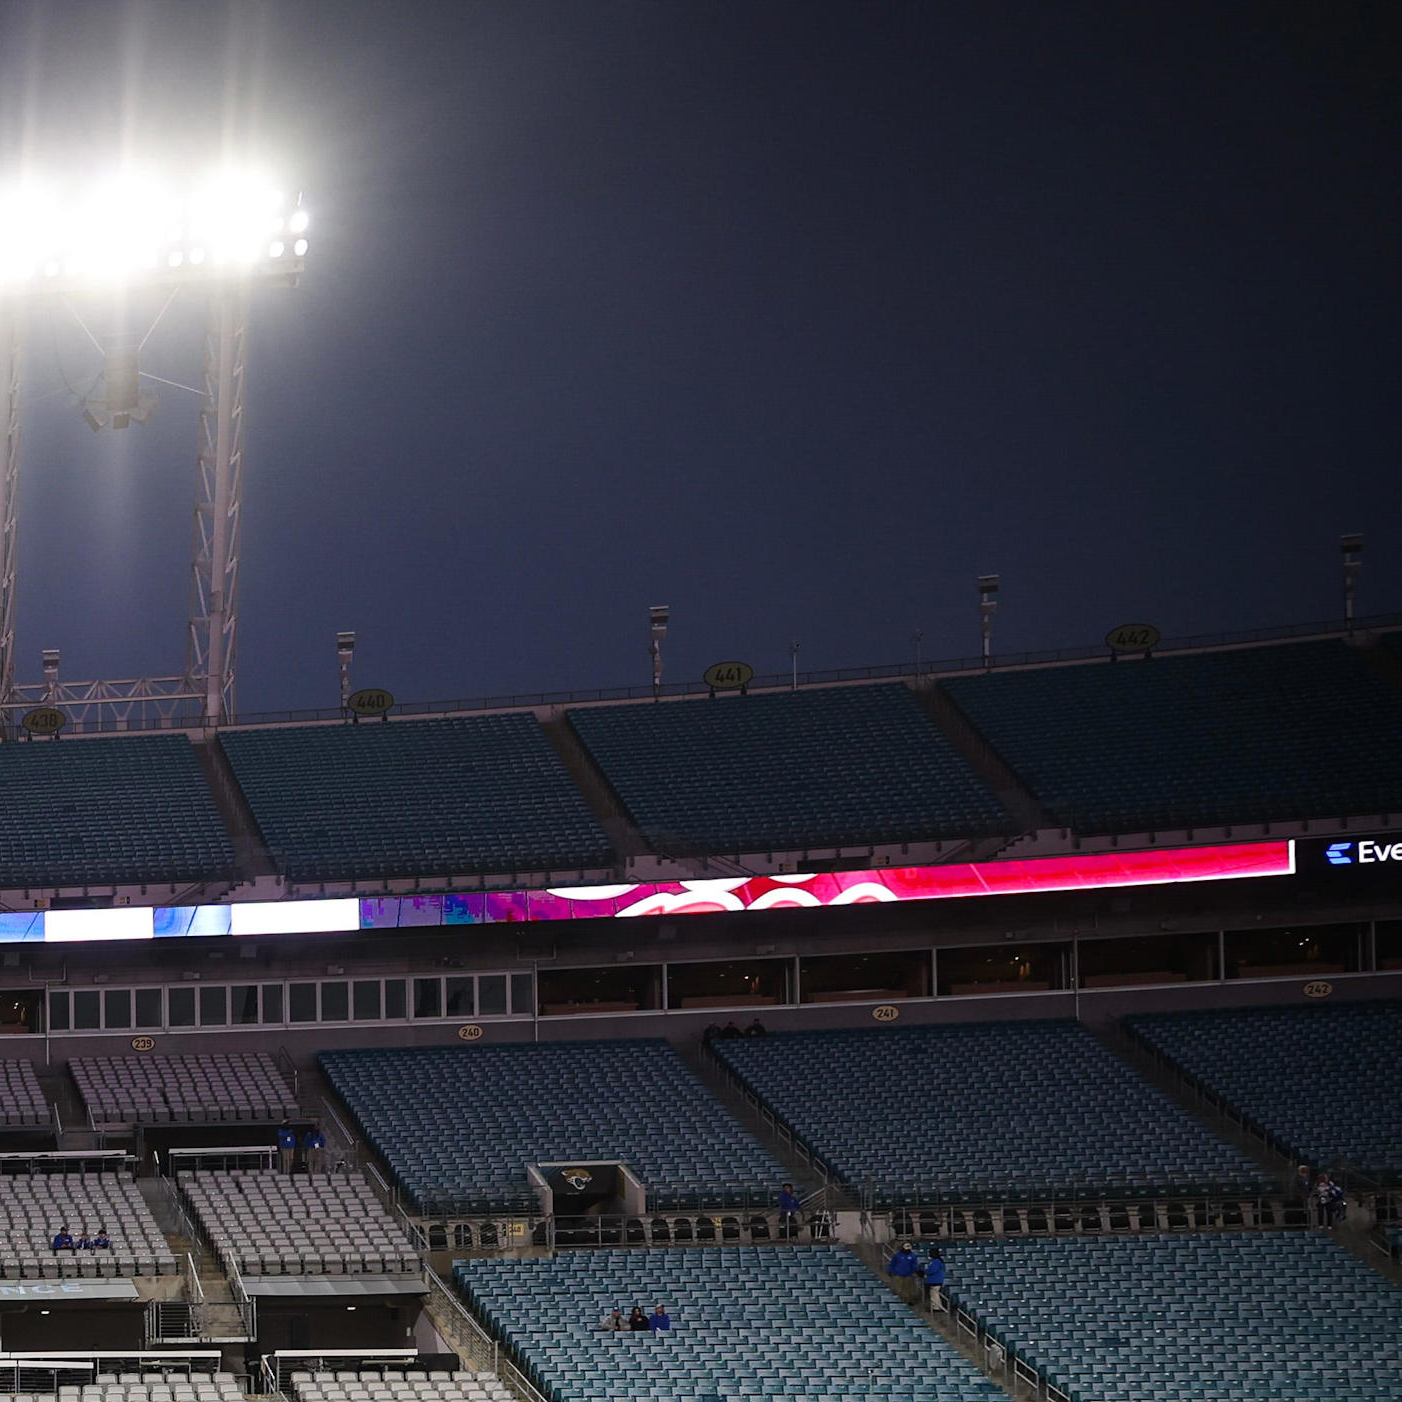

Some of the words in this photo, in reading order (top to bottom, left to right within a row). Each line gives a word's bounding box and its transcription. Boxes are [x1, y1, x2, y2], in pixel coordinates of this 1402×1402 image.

[1116, 630, 1149, 645] 442
[716, 667, 741, 683] 441
[1307, 984, 1328, 995] 242
[877, 1009, 894, 1018] 241
[462, 1028, 479, 1037] 240
[135, 1039, 152, 1048] 239
